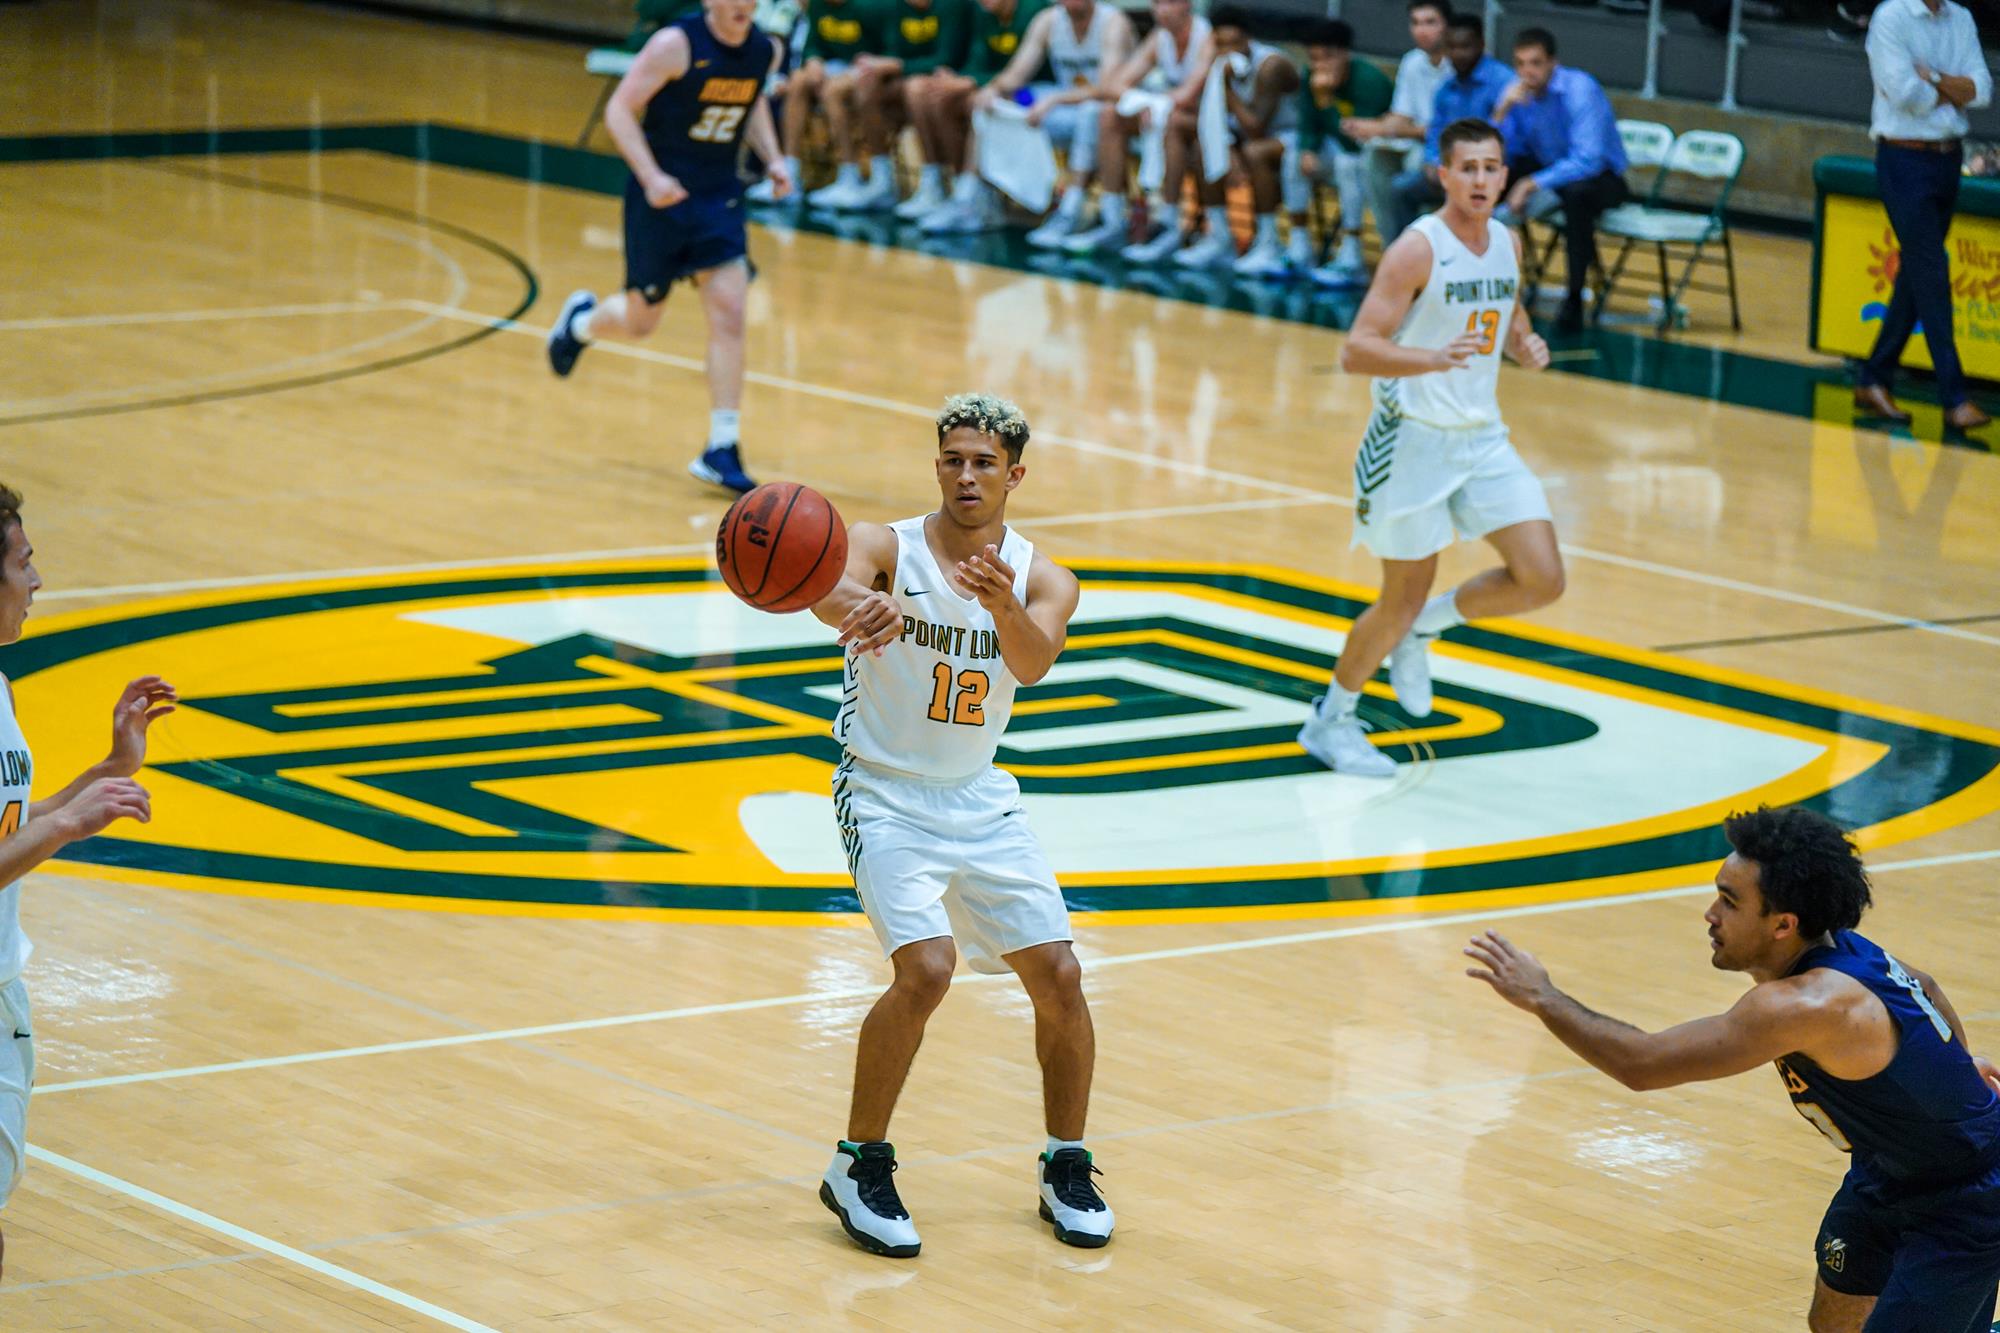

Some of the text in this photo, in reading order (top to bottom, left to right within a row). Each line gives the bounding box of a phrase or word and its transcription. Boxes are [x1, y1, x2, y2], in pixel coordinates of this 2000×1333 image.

[688, 105, 746, 142] 32
[1445, 279, 1483, 304] POINT
[1466, 309, 1501, 356] 13
[900, 614, 966, 657] POINT
[927, 661, 990, 727] 12
